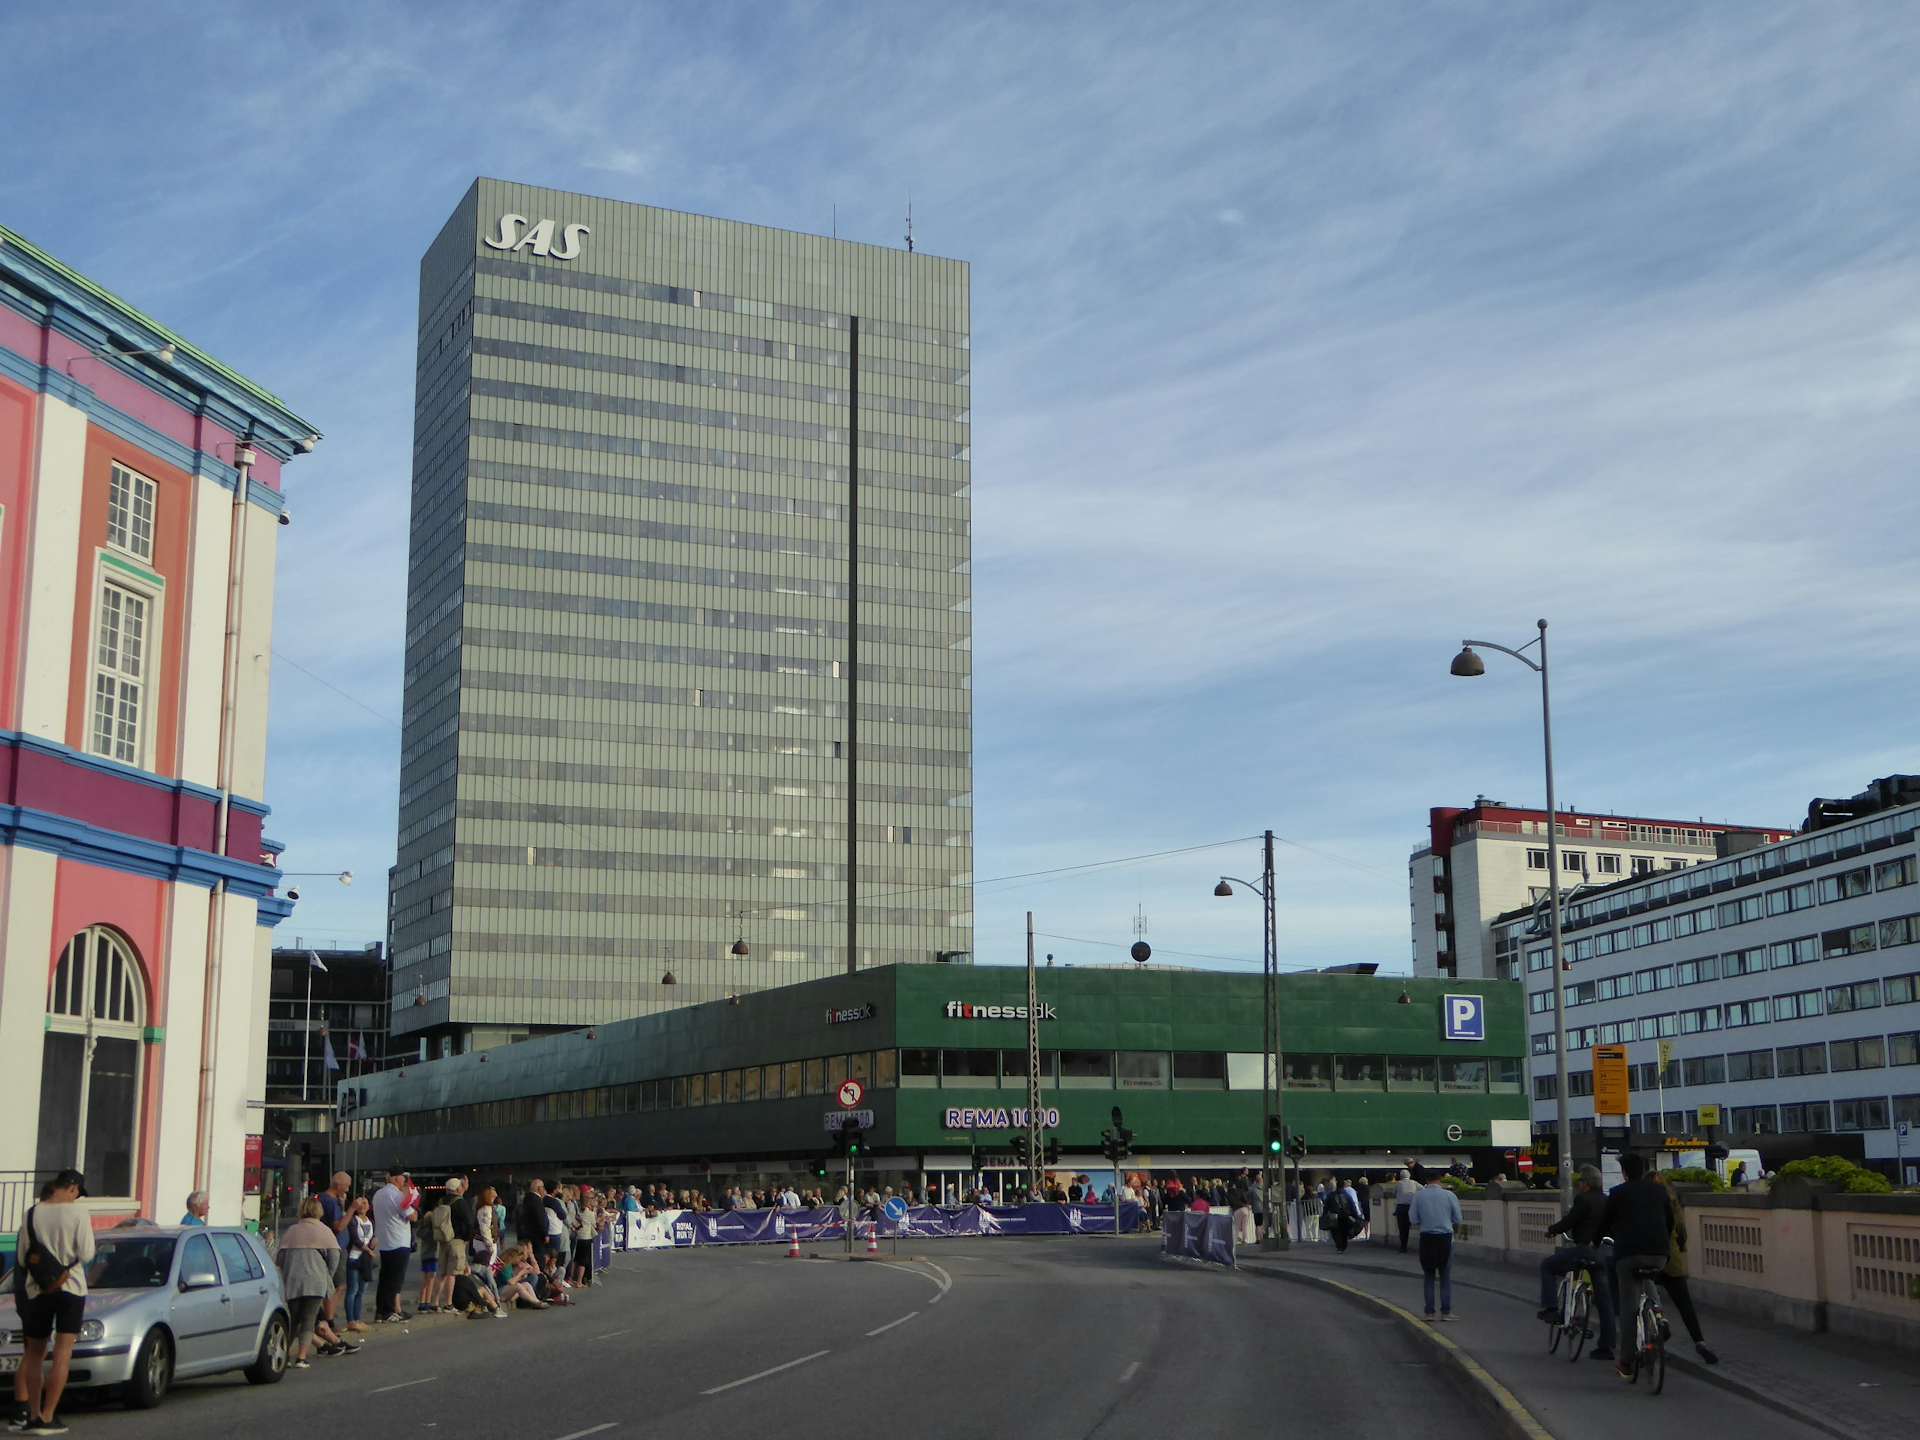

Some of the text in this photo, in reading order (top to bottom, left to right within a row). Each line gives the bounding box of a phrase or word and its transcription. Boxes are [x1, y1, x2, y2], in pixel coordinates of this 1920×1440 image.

[484, 213, 591, 260] SAS
[1453, 999, 1476, 1031] P
[945, 1108, 1009, 1128] REMA
